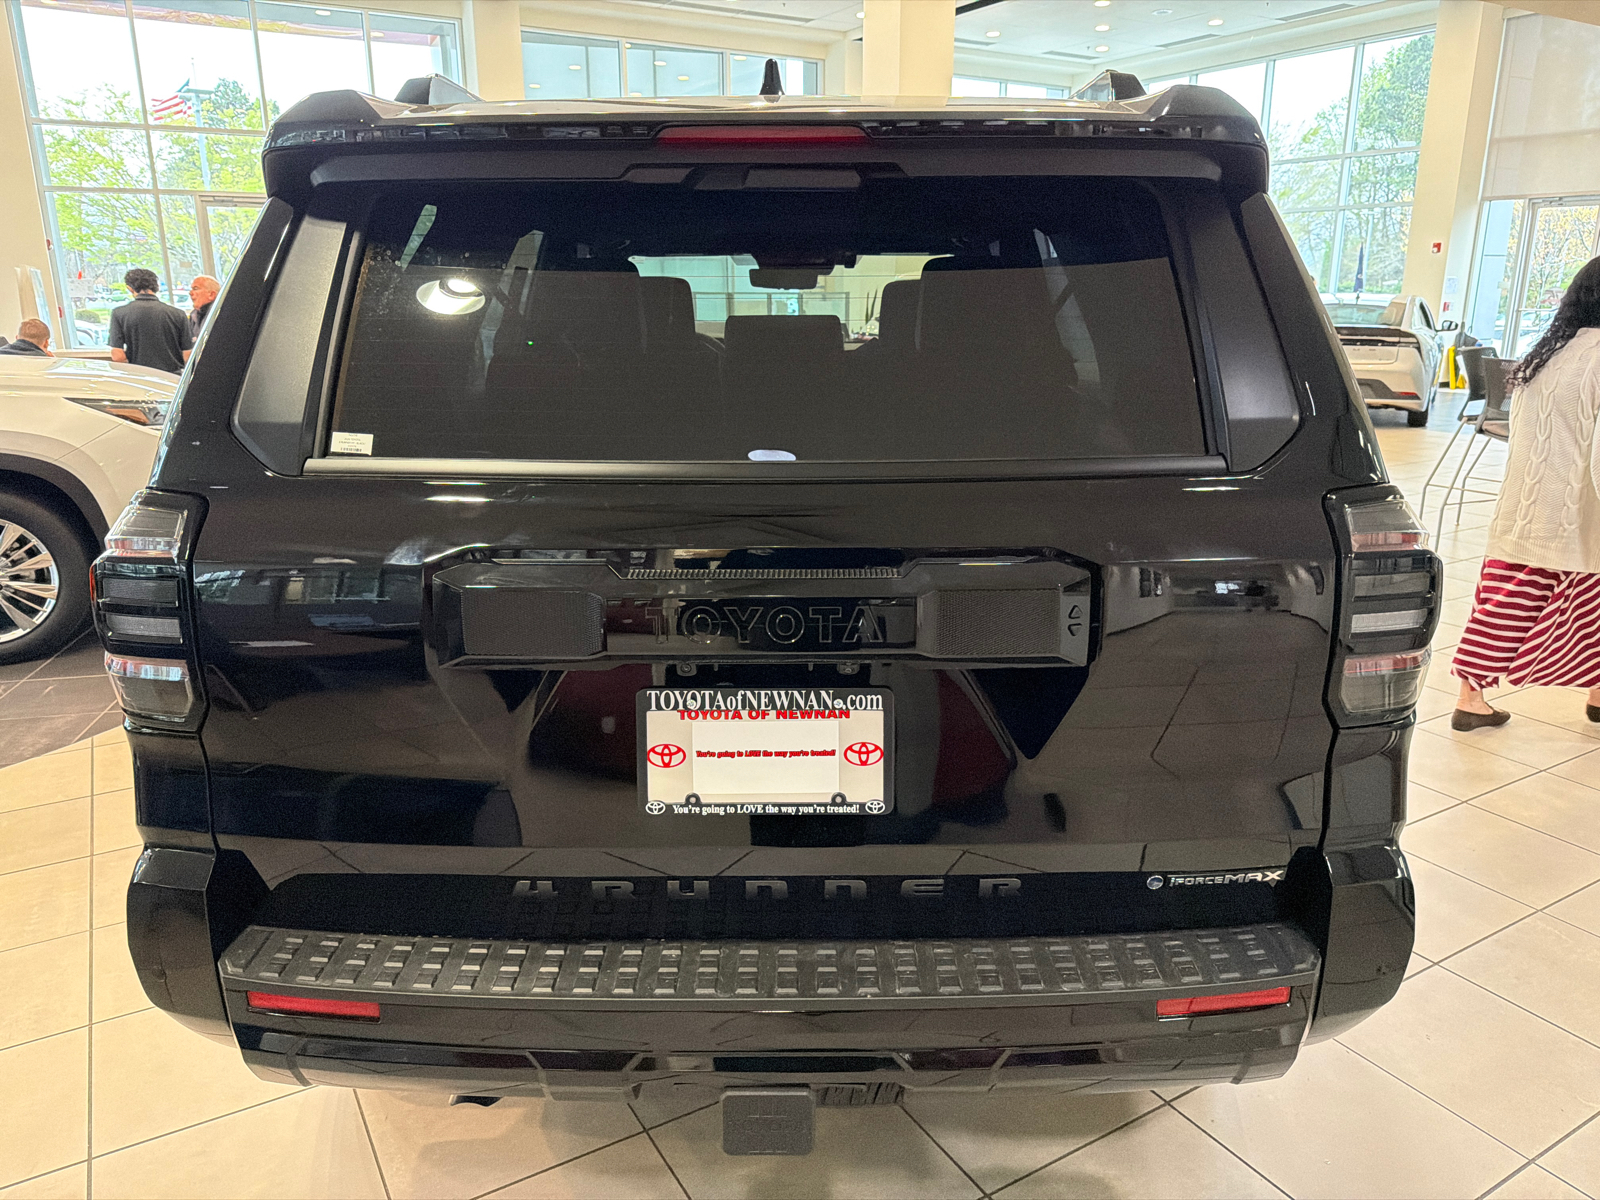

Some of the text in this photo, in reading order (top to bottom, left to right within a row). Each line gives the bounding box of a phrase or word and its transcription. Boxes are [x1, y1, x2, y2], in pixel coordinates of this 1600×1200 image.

[644, 605, 884, 644] TOYOTA
[677, 708, 851, 721] TOYOTA OF NEWNAN
[672, 804, 860, 815] You're going to LOVE the way you're treated!
[512, 878, 1023, 899] 4RUNNER
